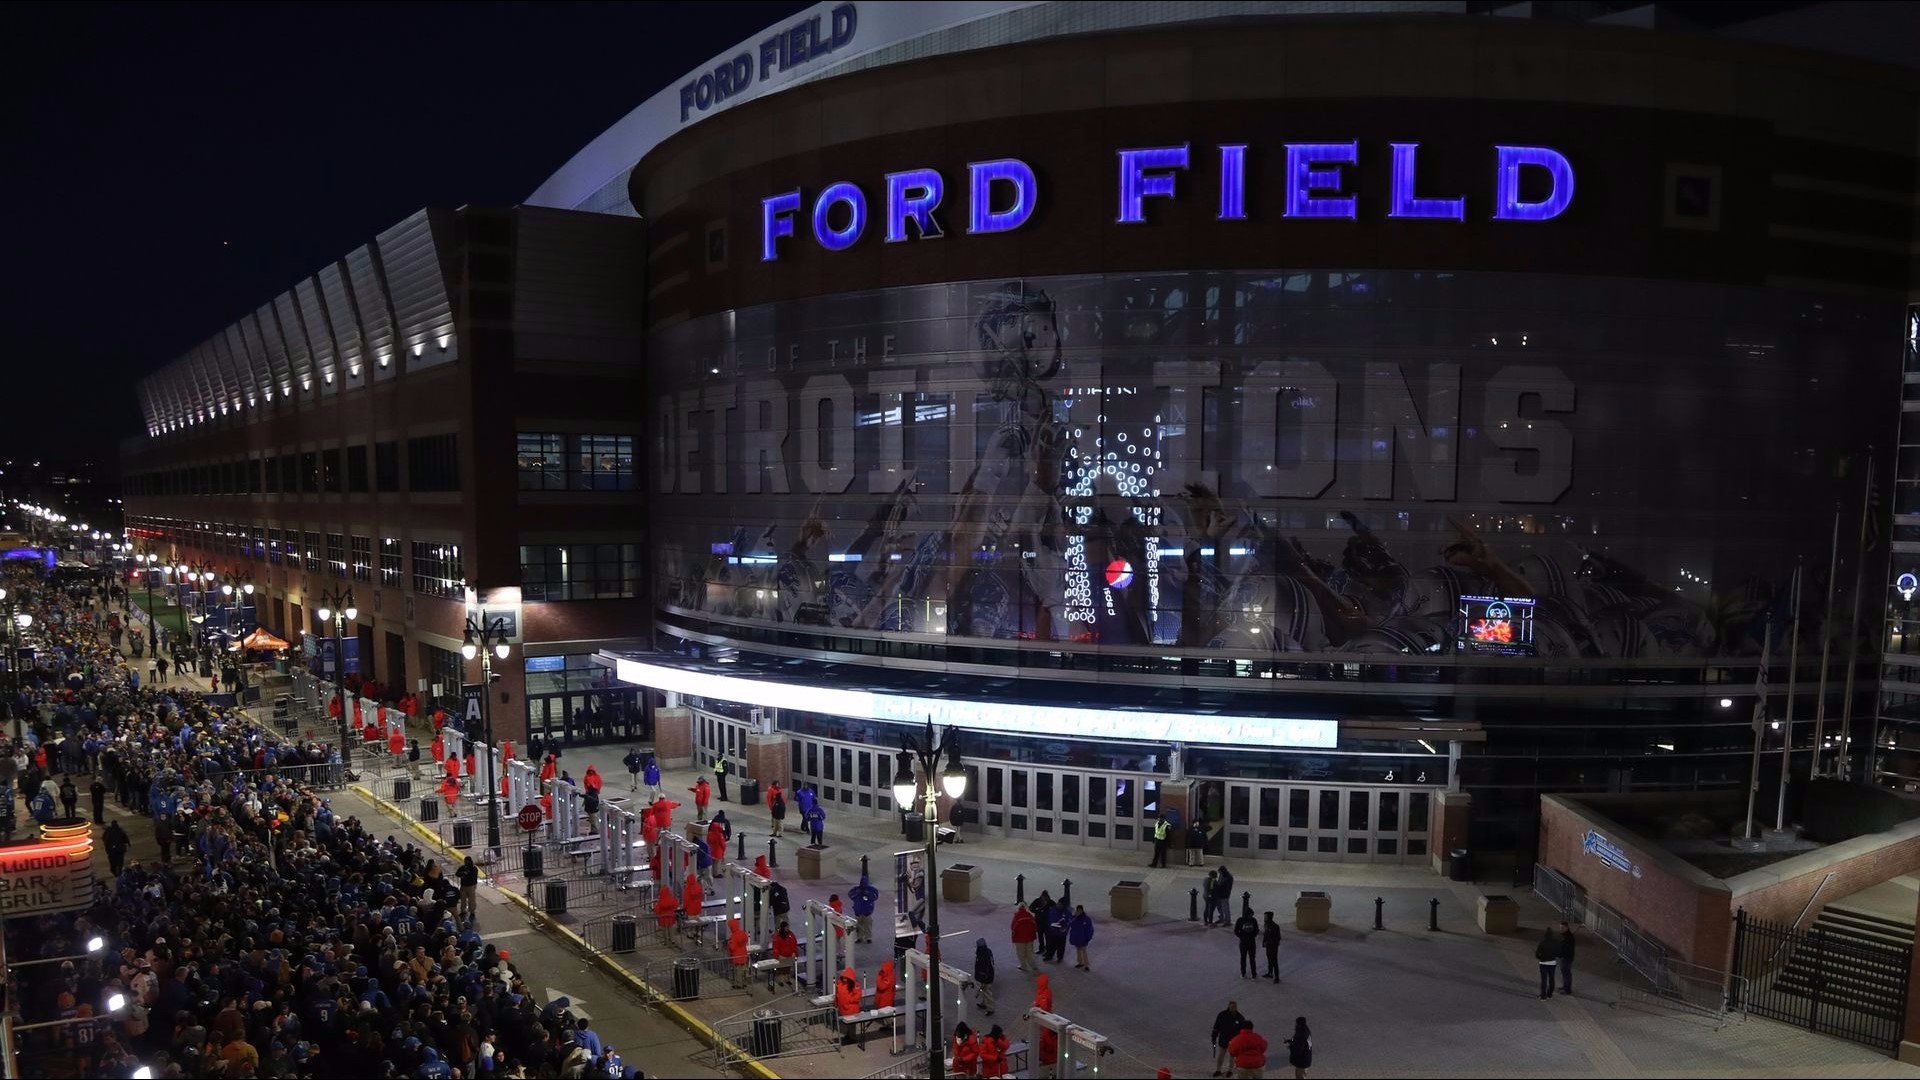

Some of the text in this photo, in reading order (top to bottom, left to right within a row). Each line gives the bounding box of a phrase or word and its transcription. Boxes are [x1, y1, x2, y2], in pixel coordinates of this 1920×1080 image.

[680, 3, 857, 123] FORD FIELD
[760, 138, 1576, 263] FORD FIELD
[768, 344, 800, 372] OF
[828, 334, 897, 368] THE
[659, 367, 992, 495] DETROIT
[465, 698, 482, 721] A
[519, 811, 541, 824] STOP
[0, 891, 63, 909] GRILL
[398, 921, 411, 935] 81
[78, 1027, 95, 1044] 81
